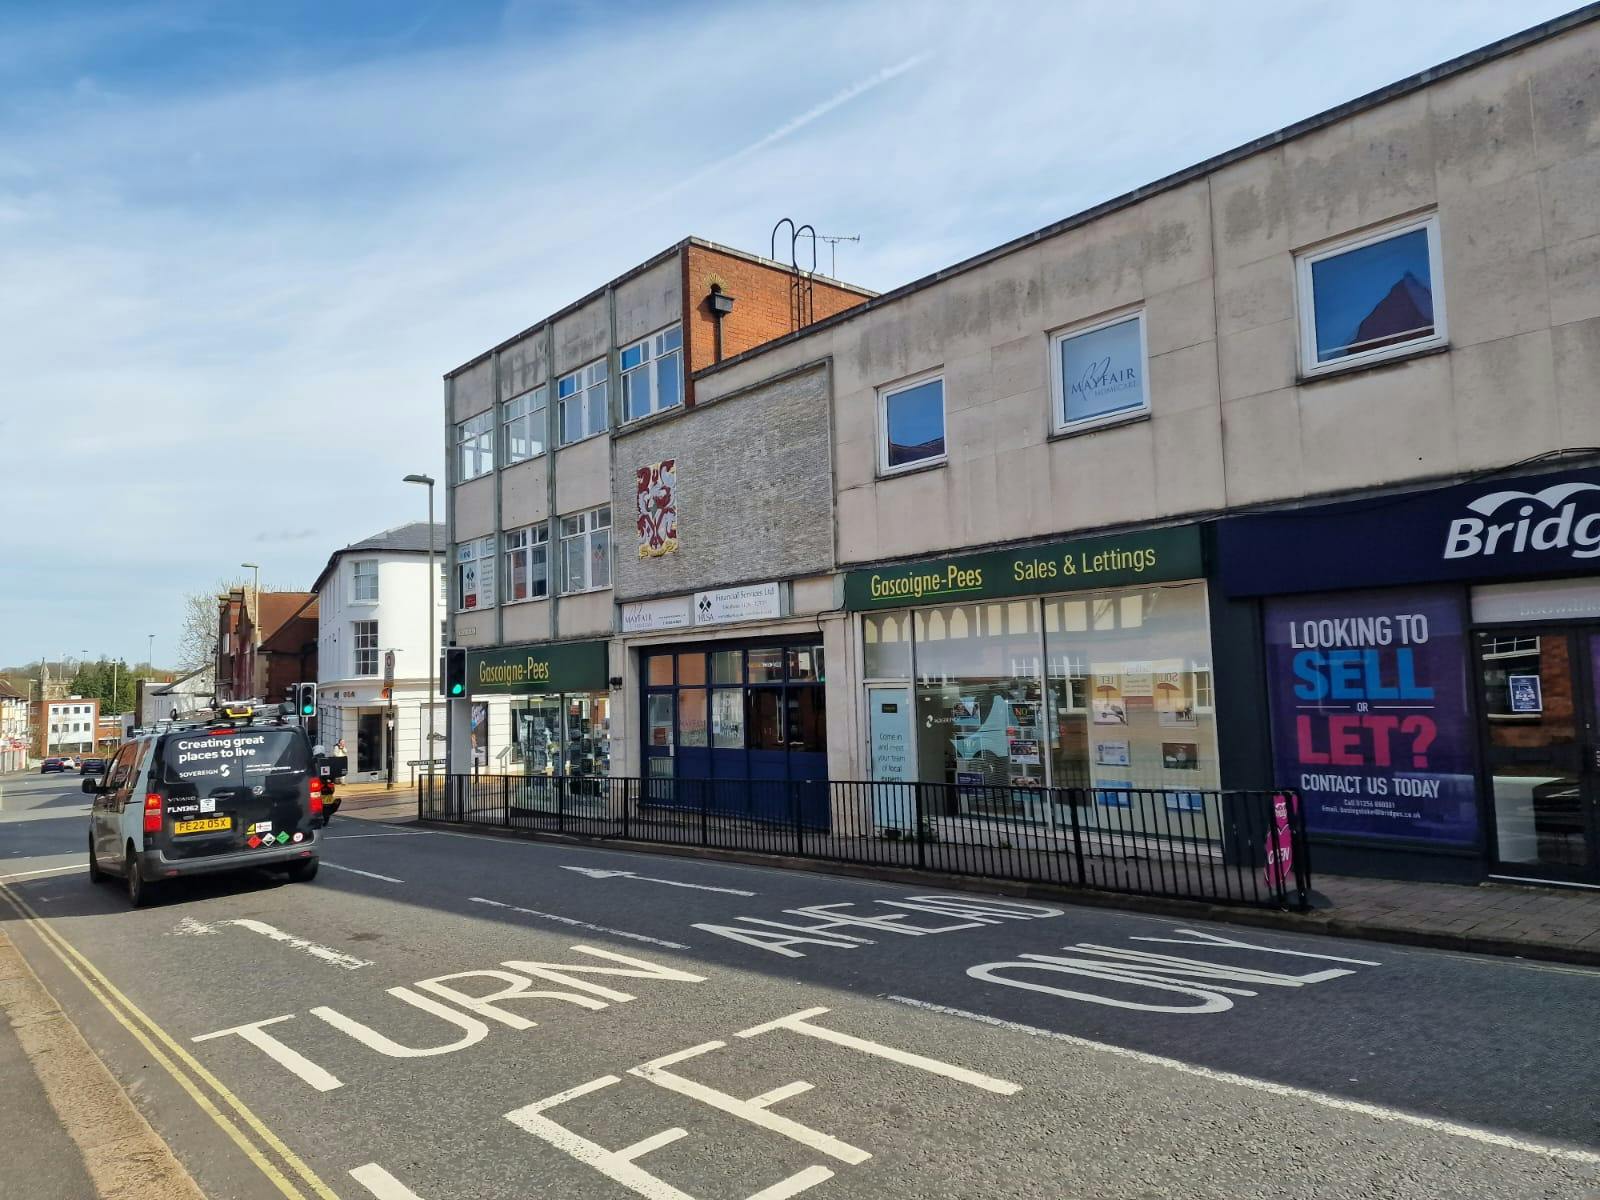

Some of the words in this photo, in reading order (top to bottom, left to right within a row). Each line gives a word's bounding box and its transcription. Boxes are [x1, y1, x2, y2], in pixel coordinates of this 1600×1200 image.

[1071, 368, 1135, 395] MAYFAIR
[1014, 559, 1057, 581] Sales
[1063, 554, 1077, 576] &
[1082, 548, 1156, 575] Lettings
[871, 565, 982, 598] Gascoigne-Pees
[1290, 616, 1393, 649] LOOKING
[1396, 614, 1429, 645] TO
[480, 656, 549, 686] Gascoigne-Pees
[1293, 647, 1436, 700] SELL
[1356, 702, 1369, 712] OR
[178, 738, 231, 750] Creating
[233, 735, 265, 748] great
[179, 751, 218, 764] places
[220, 748, 233, 758] to
[235, 747, 256, 757] live
[1296, 714, 1437, 769] LET?
[179, 769, 219, 778] SOVEREIGN
[1301, 774, 1362, 794] CONTACT
[1366, 777, 1388, 796] US
[1392, 778, 1440, 799] TODAY
[179, 819, 205, 832] FE22
[690, 896, 1065, 958] AHEAD
[966, 929, 1382, 1014] ONLY
[191, 945, 708, 1092] TURN
[349, 1006, 1023, 1200] EFT
